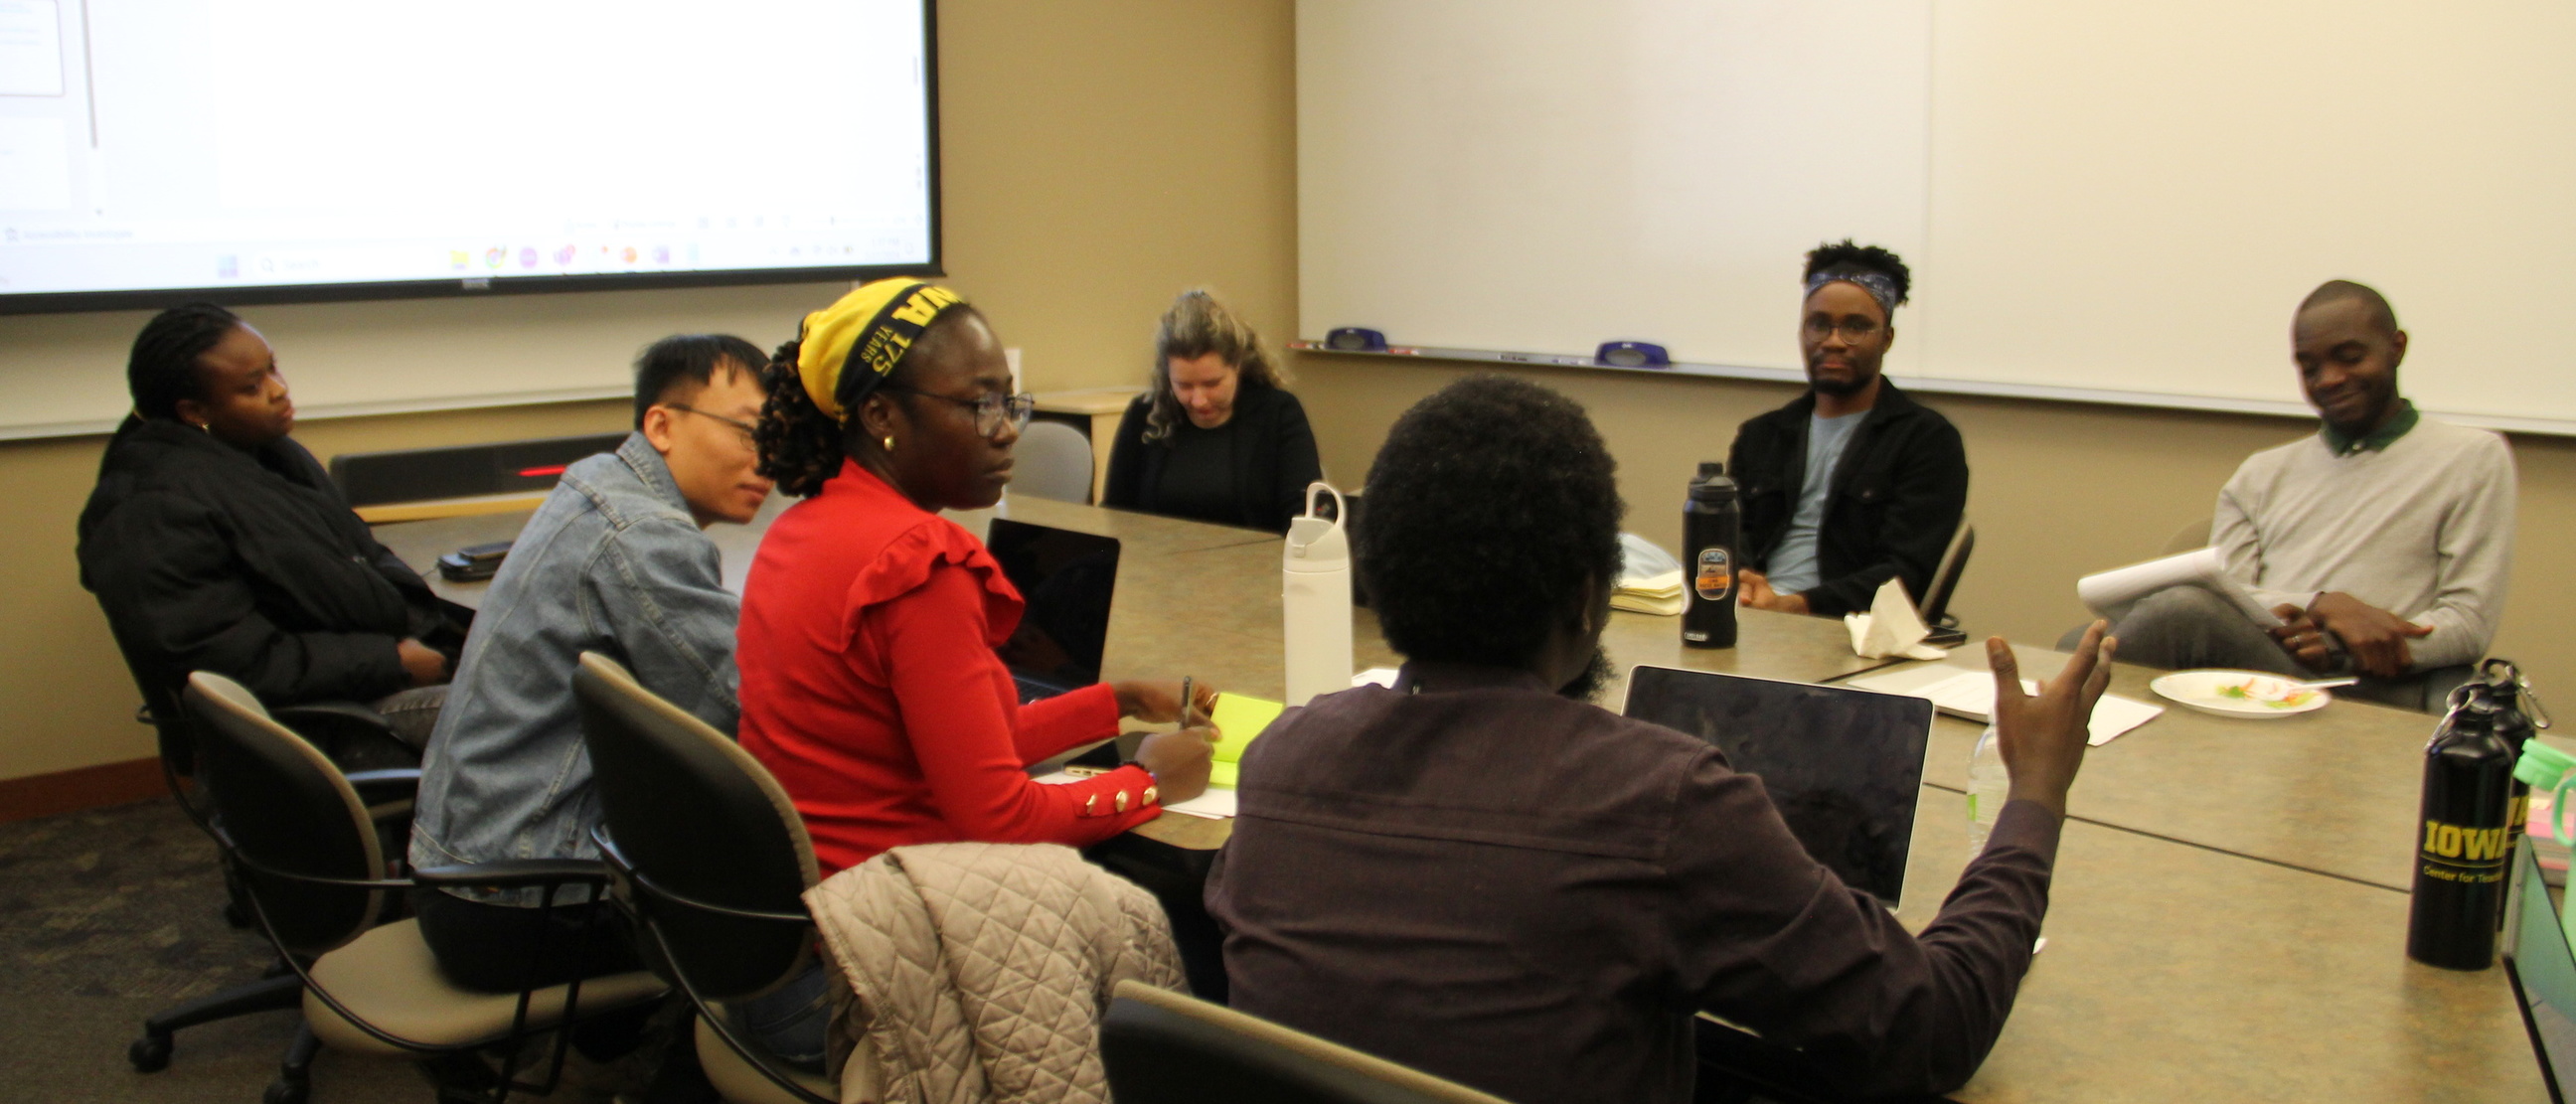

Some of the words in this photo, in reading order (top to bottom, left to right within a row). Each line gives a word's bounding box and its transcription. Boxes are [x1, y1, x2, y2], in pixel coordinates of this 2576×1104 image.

[890, 285, 963, 328] WA
[861, 325, 893, 363] YEARS
[872, 333, 911, 378] 175
[2423, 865, 2458, 881] Center
[2459, 871, 2476, 883] for
